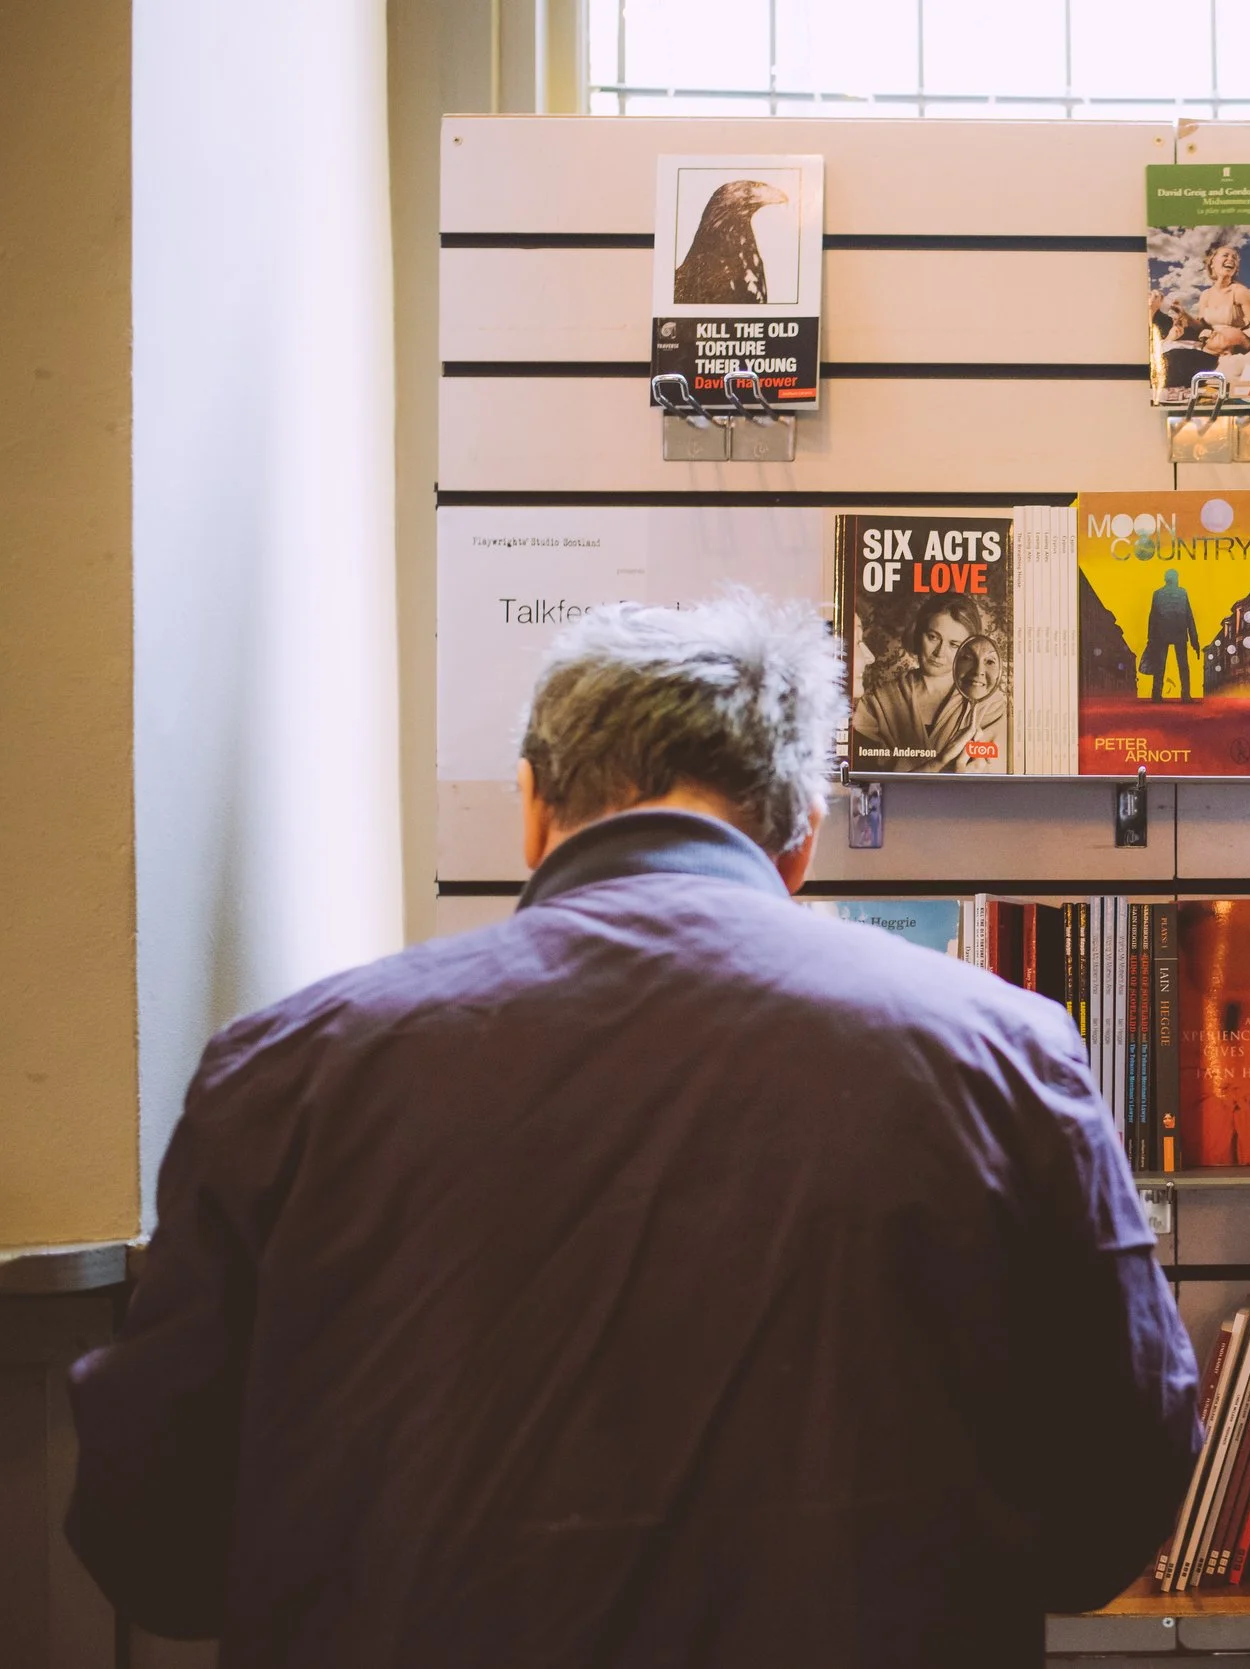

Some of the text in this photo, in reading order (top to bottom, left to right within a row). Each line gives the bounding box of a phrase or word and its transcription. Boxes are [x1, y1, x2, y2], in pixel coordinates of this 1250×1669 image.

[1157, 188, 1182, 197] David
[1183, 188, 1206, 198] Greig
[1207, 188, 1224, 196] and
[696, 322, 799, 339] KILL THE OLD
[696, 341, 766, 356] TORTURE
[695, 358, 797, 374] THEIR YOUNG
[694, 376, 798, 389] Davi Harower
[1088, 513, 1176, 538] MOON
[531, 538, 559, 547] Studio
[563, 538, 601, 547] Scotland
[863, 529, 1001, 562] SIX ACTS
[863, 561, 988, 593] OF LOVE
[498, 598, 606, 624] Talkfes
[968, 744, 995, 755] tron
[1095, 738, 1147, 750] PETER
[893, 747, 937, 758] Anderson
[1125, 750, 1191, 763] ARNOTT
[871, 917, 917, 931] Heggie
[1160, 967, 1170, 1046] IAIN HEGGIE
[1204, 1046, 1245, 1057] GIVES
[1196, 1068, 1235, 1079] IAIN
